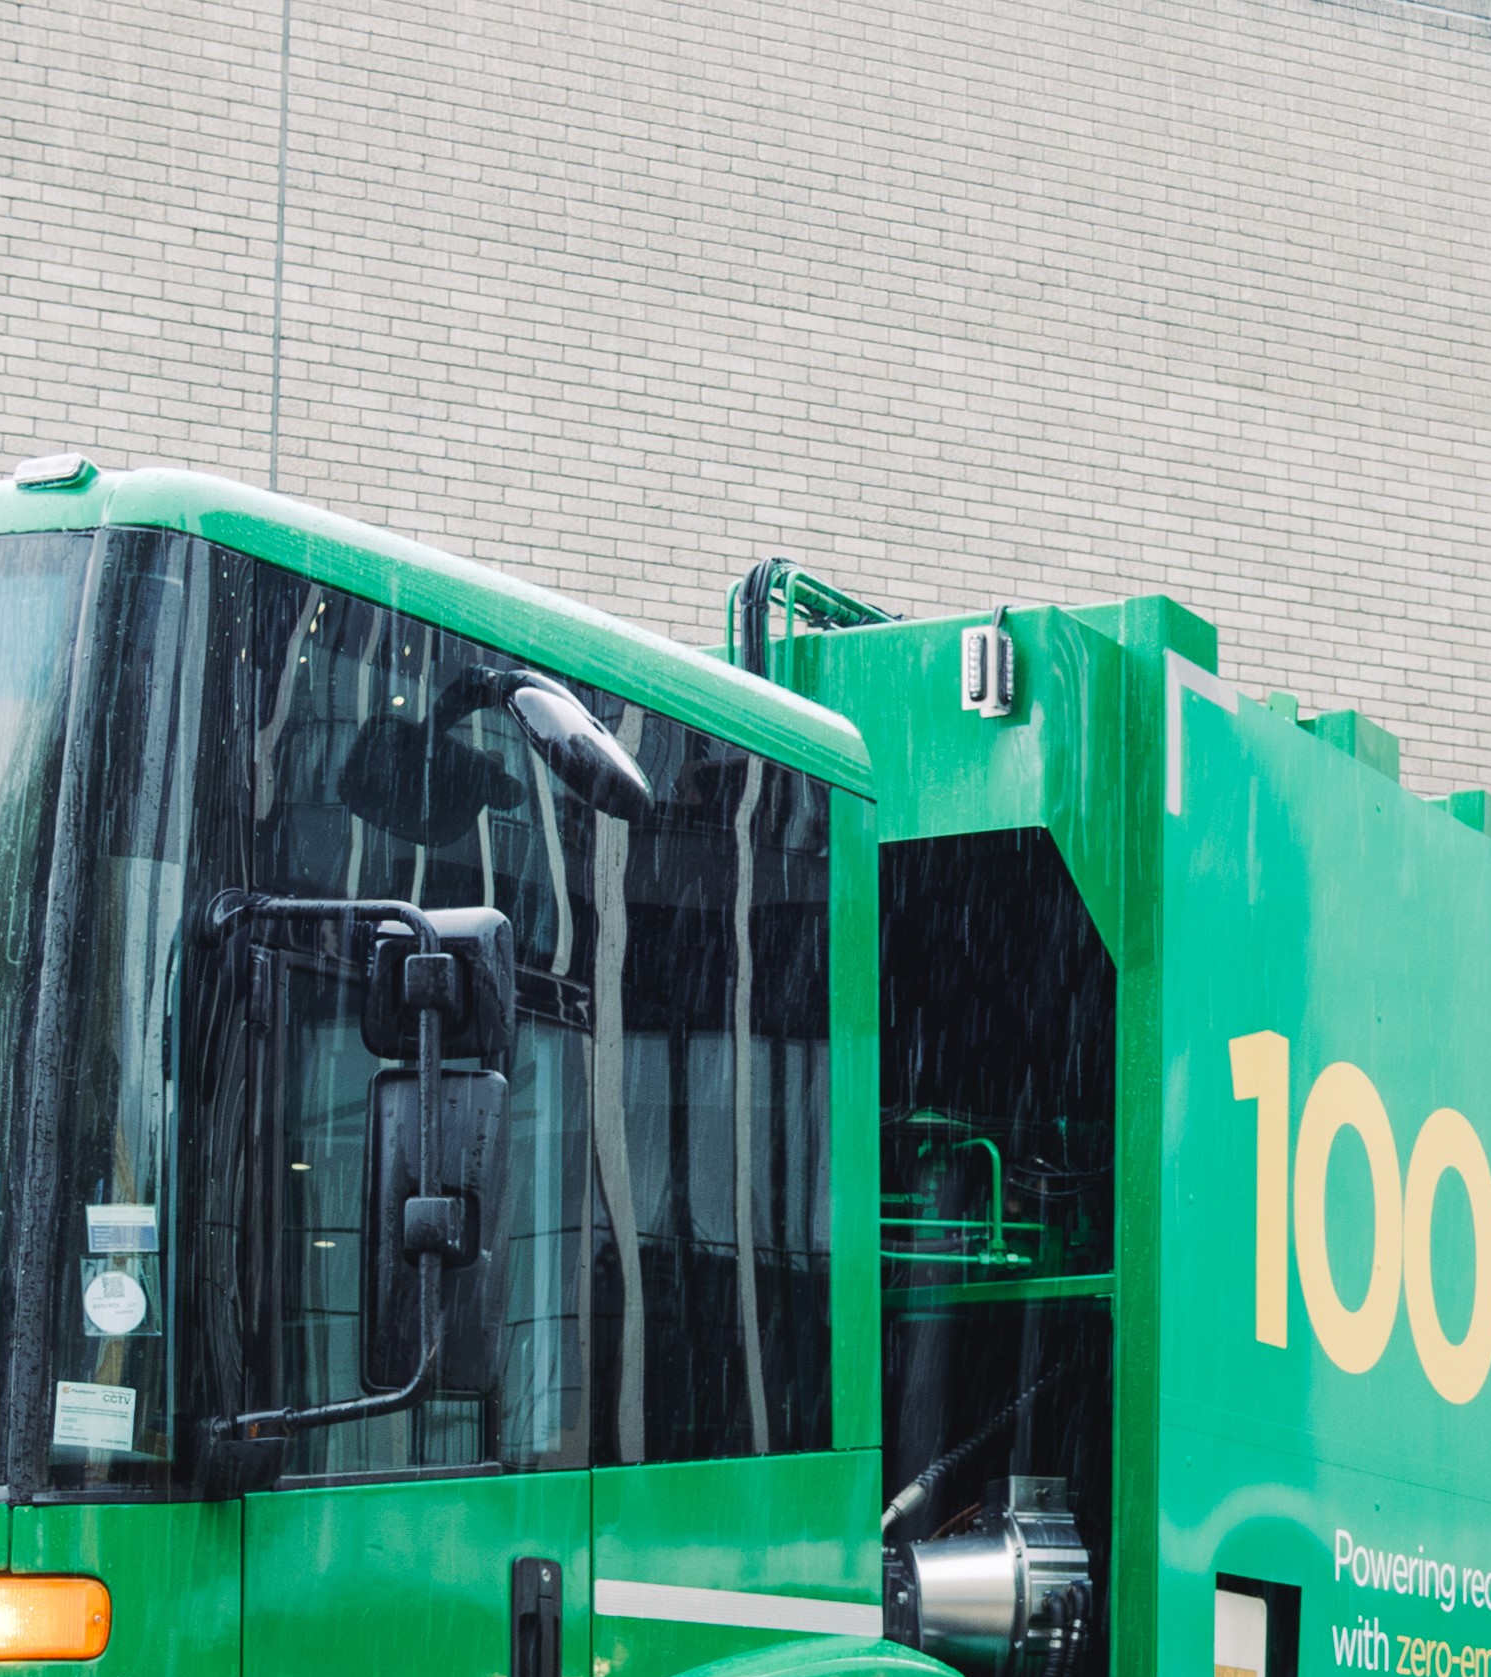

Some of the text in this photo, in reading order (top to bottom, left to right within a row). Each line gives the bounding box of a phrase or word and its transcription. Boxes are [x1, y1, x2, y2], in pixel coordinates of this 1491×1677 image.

[103, 1394, 132, 1405] CCTV
[1334, 1528, 1456, 1613] Powering
[1332, 1615, 1389, 1672] with
